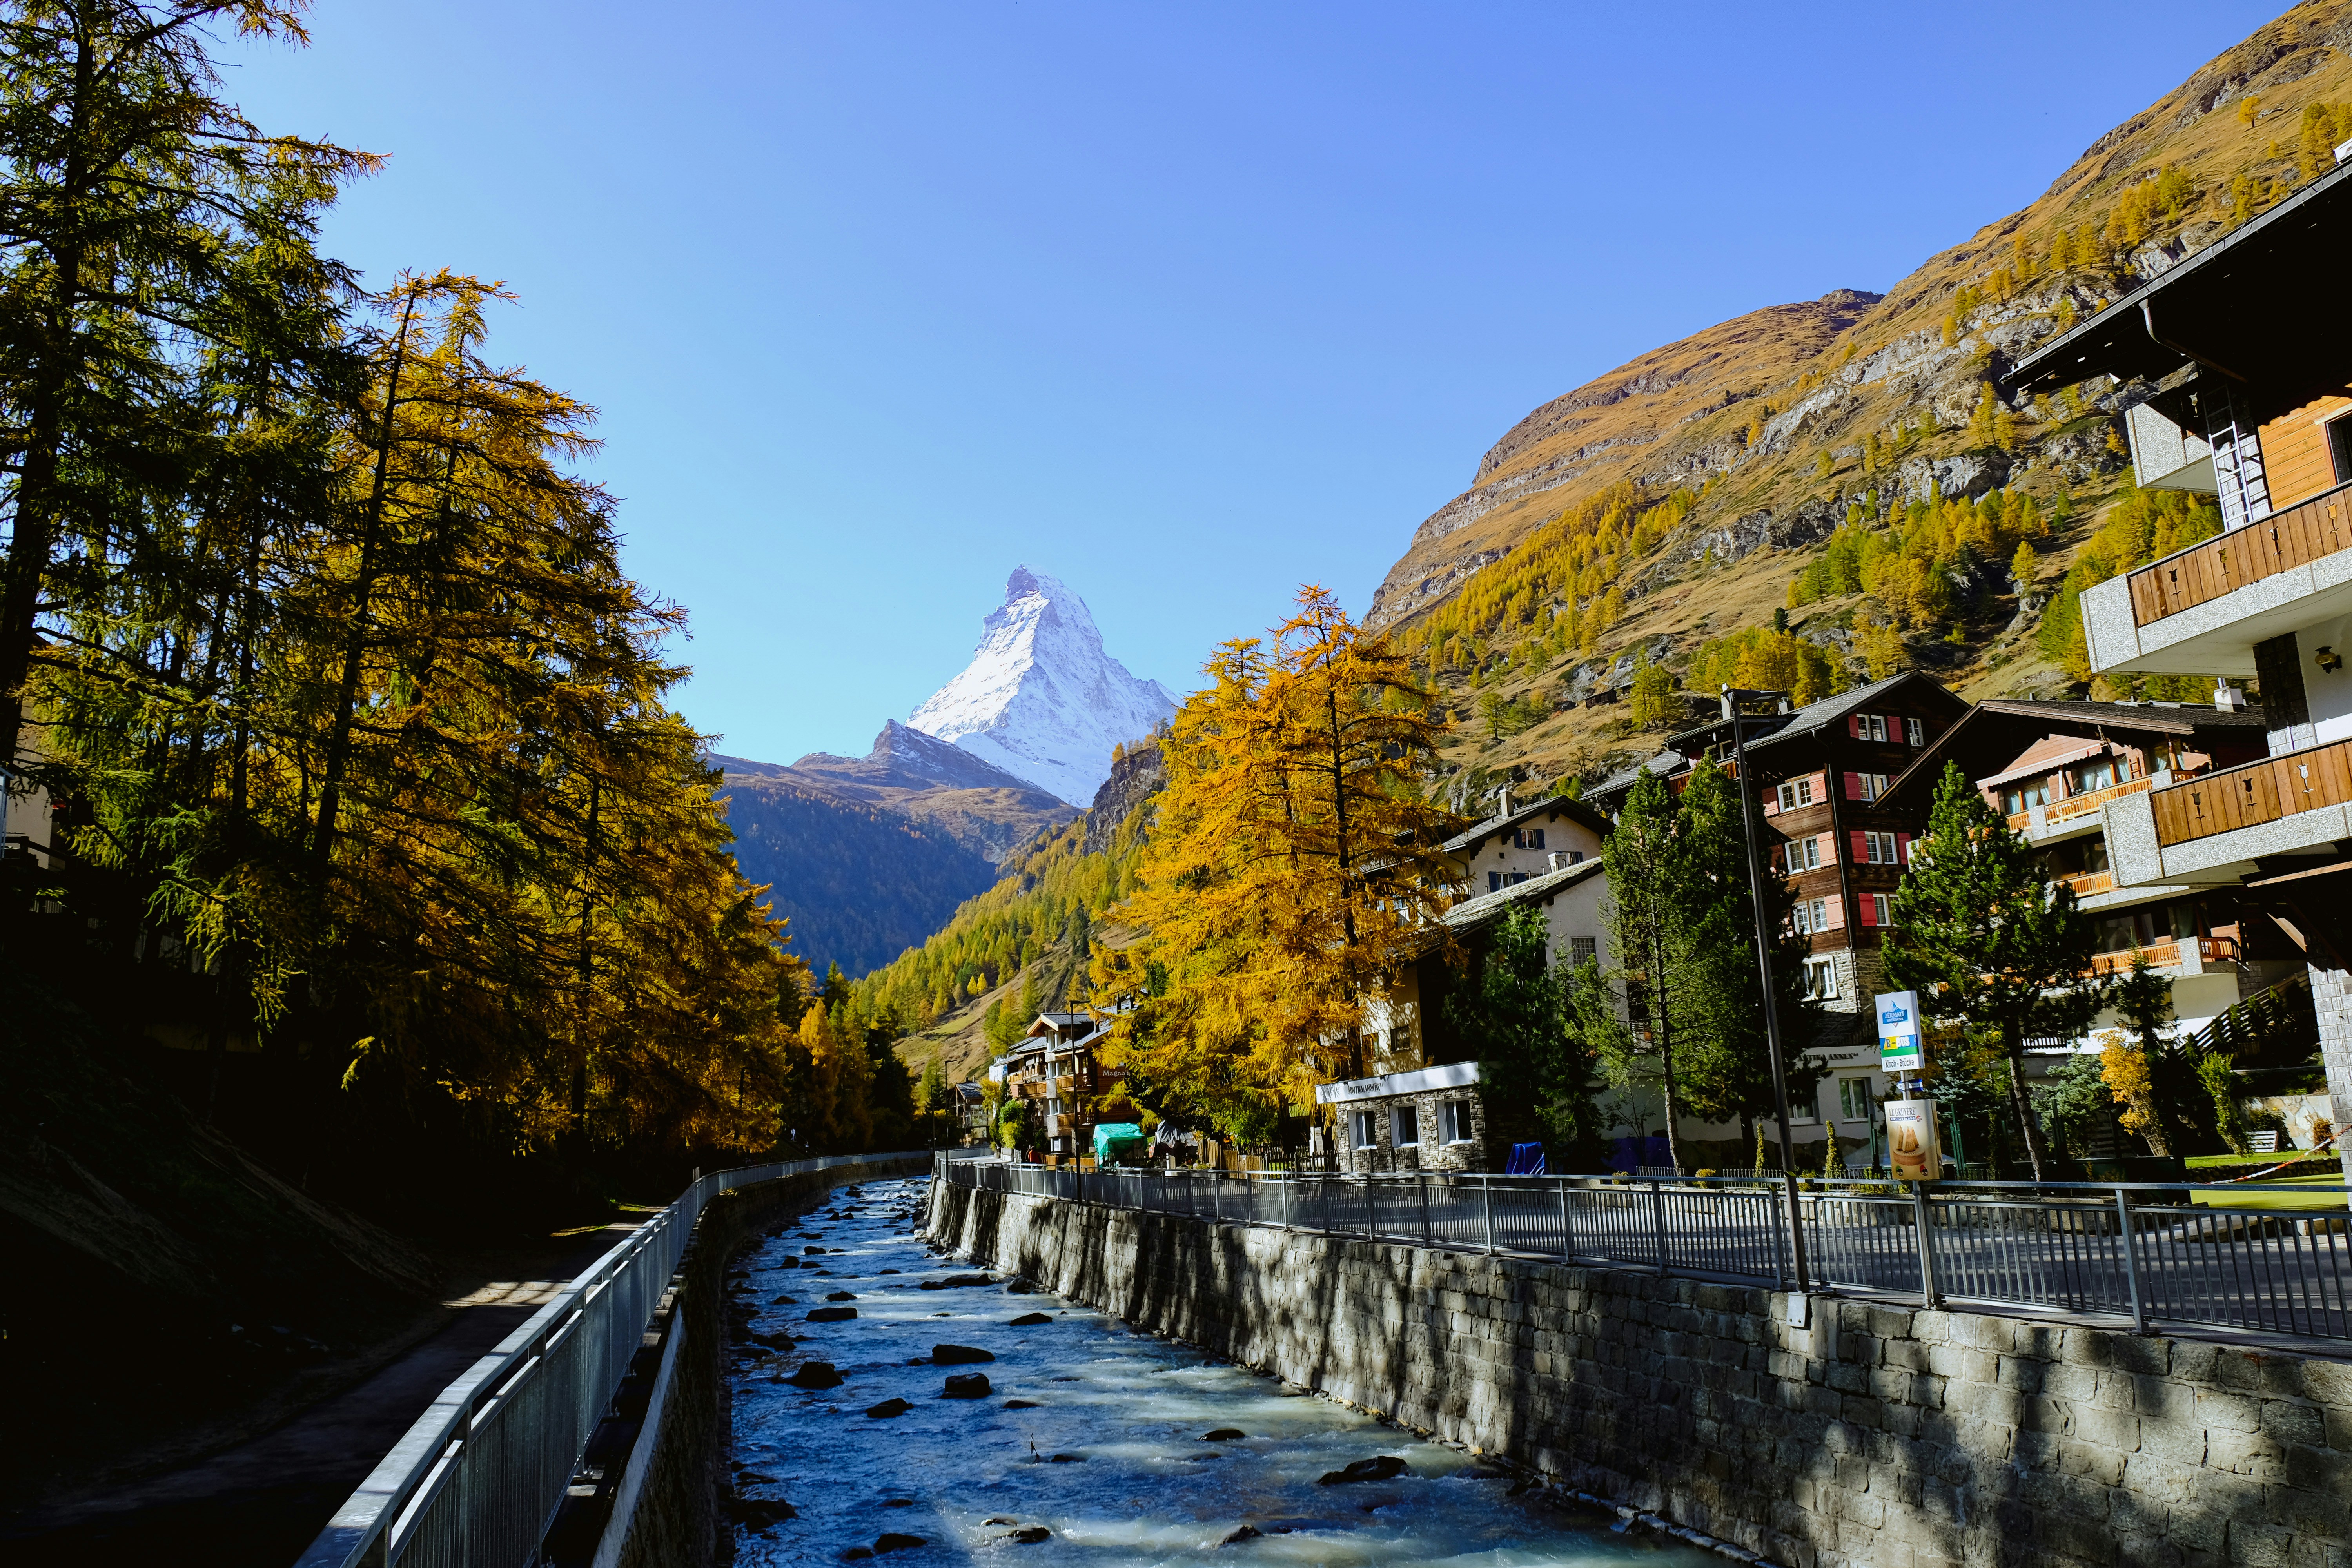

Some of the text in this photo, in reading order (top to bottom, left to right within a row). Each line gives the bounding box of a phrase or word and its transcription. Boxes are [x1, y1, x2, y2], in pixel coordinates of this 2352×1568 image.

[1885, 1060, 1896, 1068] Kirch
[1899, 1058, 1914, 1067] Brücke
[1895, 1106, 1915, 1116] GRUYÈRE
